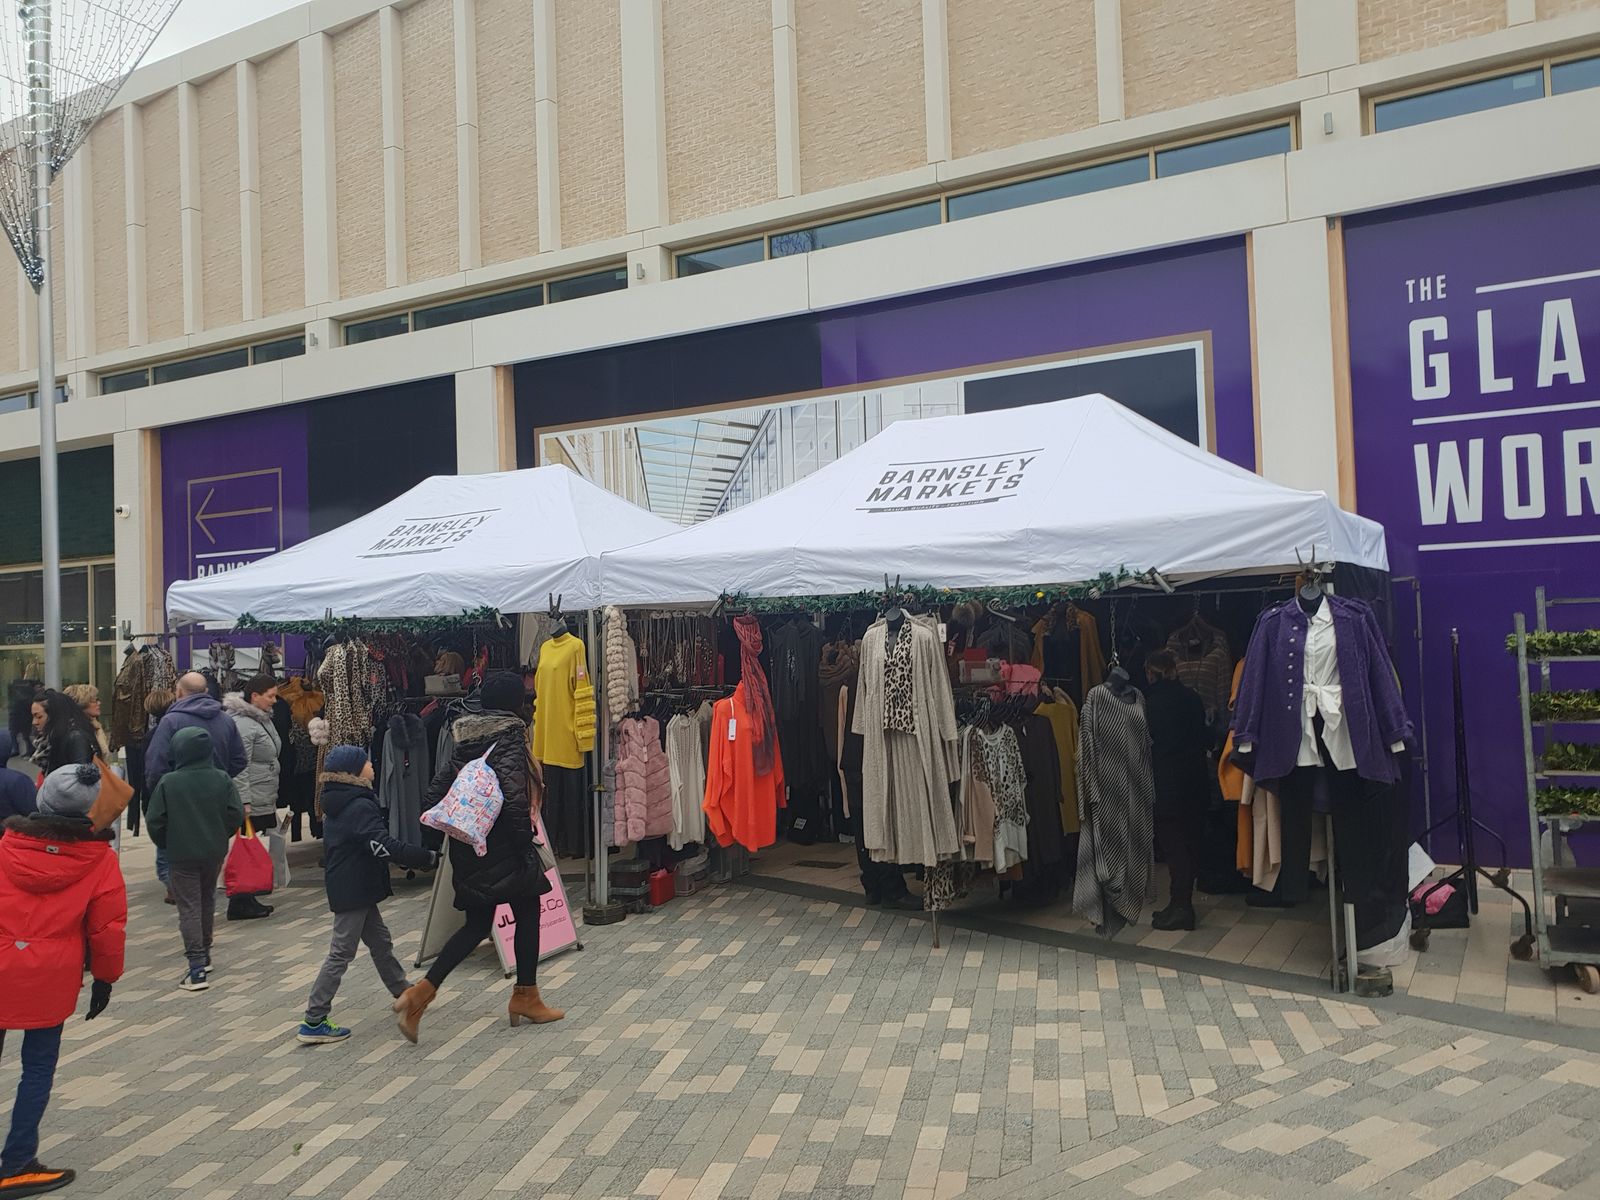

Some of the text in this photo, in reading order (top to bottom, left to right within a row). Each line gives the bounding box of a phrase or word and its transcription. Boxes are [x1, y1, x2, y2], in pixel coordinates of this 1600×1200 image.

[1405, 274, 1447, 303] THE
[1408, 298, 1586, 401] GLA
[879, 456, 1036, 485] BARNSLEY
[1413, 427, 1600, 526] WOR
[866, 473, 1024, 502] MARKETS
[368, 529, 473, 551] MARKETS
[388, 515, 492, 537] BARNSLEY
